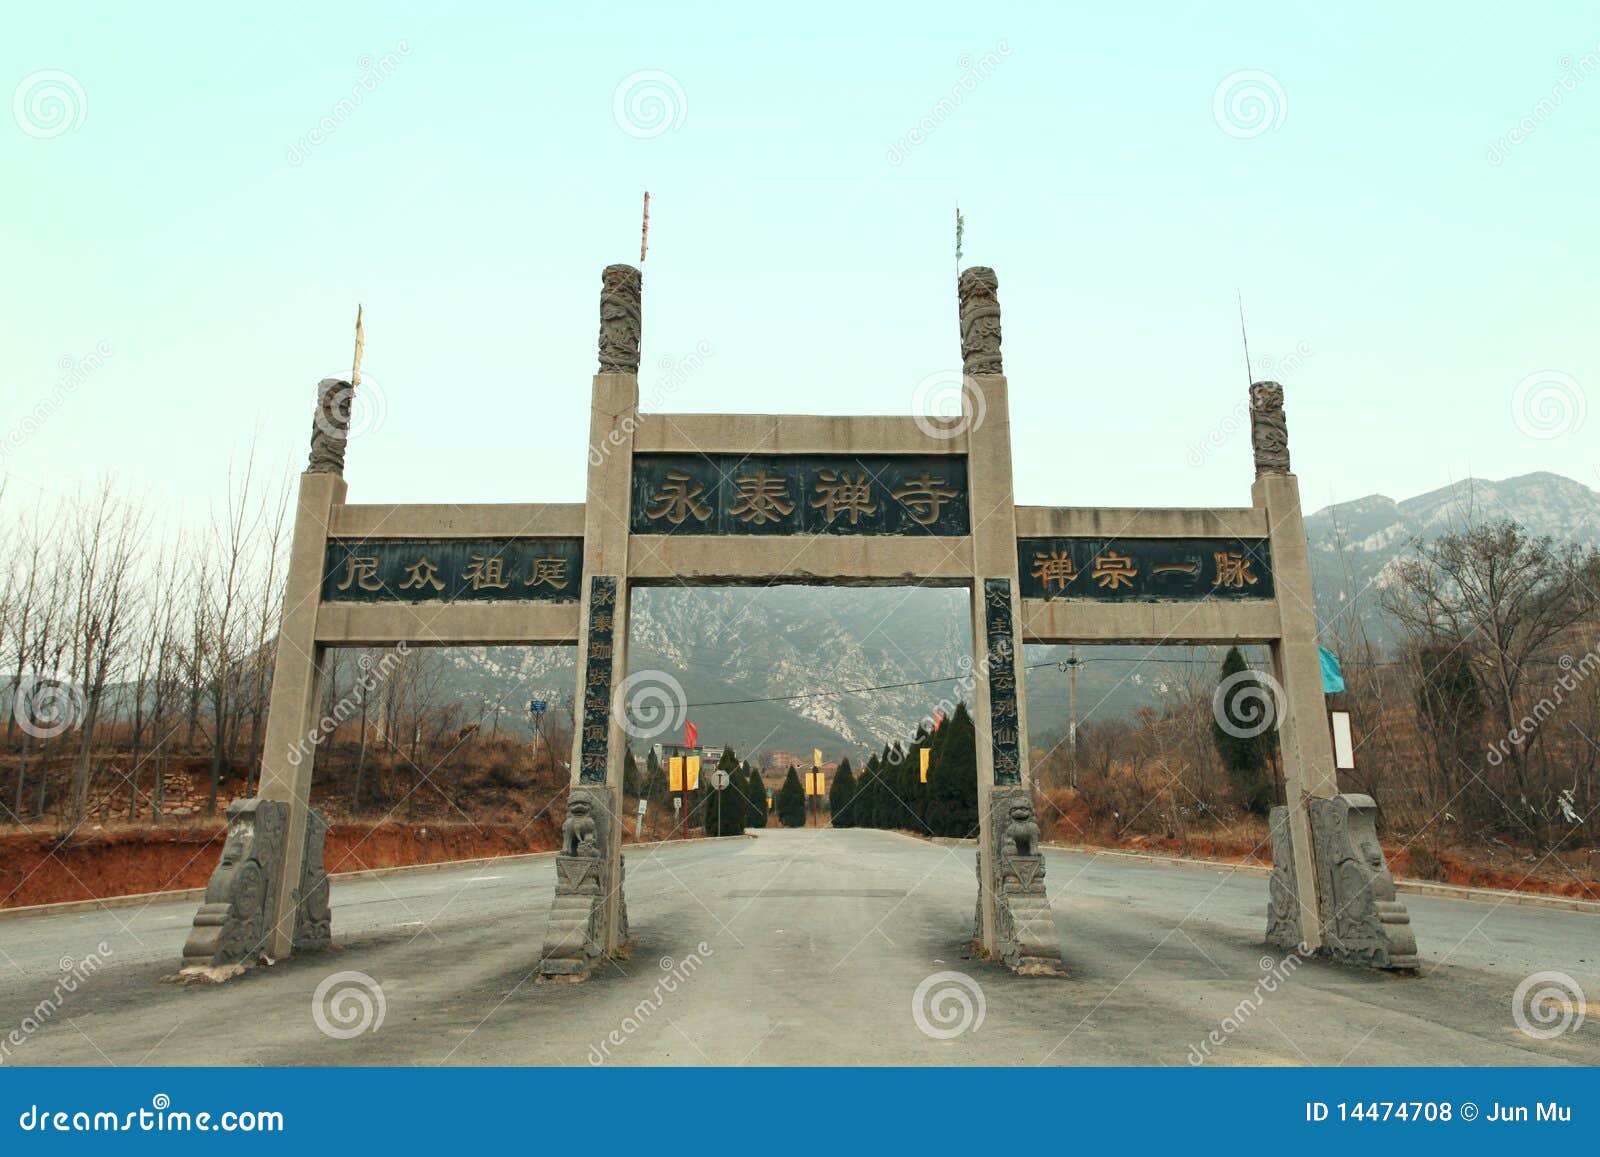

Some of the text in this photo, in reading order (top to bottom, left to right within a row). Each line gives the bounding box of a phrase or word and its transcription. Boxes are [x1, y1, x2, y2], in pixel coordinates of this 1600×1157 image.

[647, 470, 958, 525] 永泰禅寺
[336, 554, 569, 591] 尼众祖庭
[1031, 550, 1258, 589] 禅宗一脉
